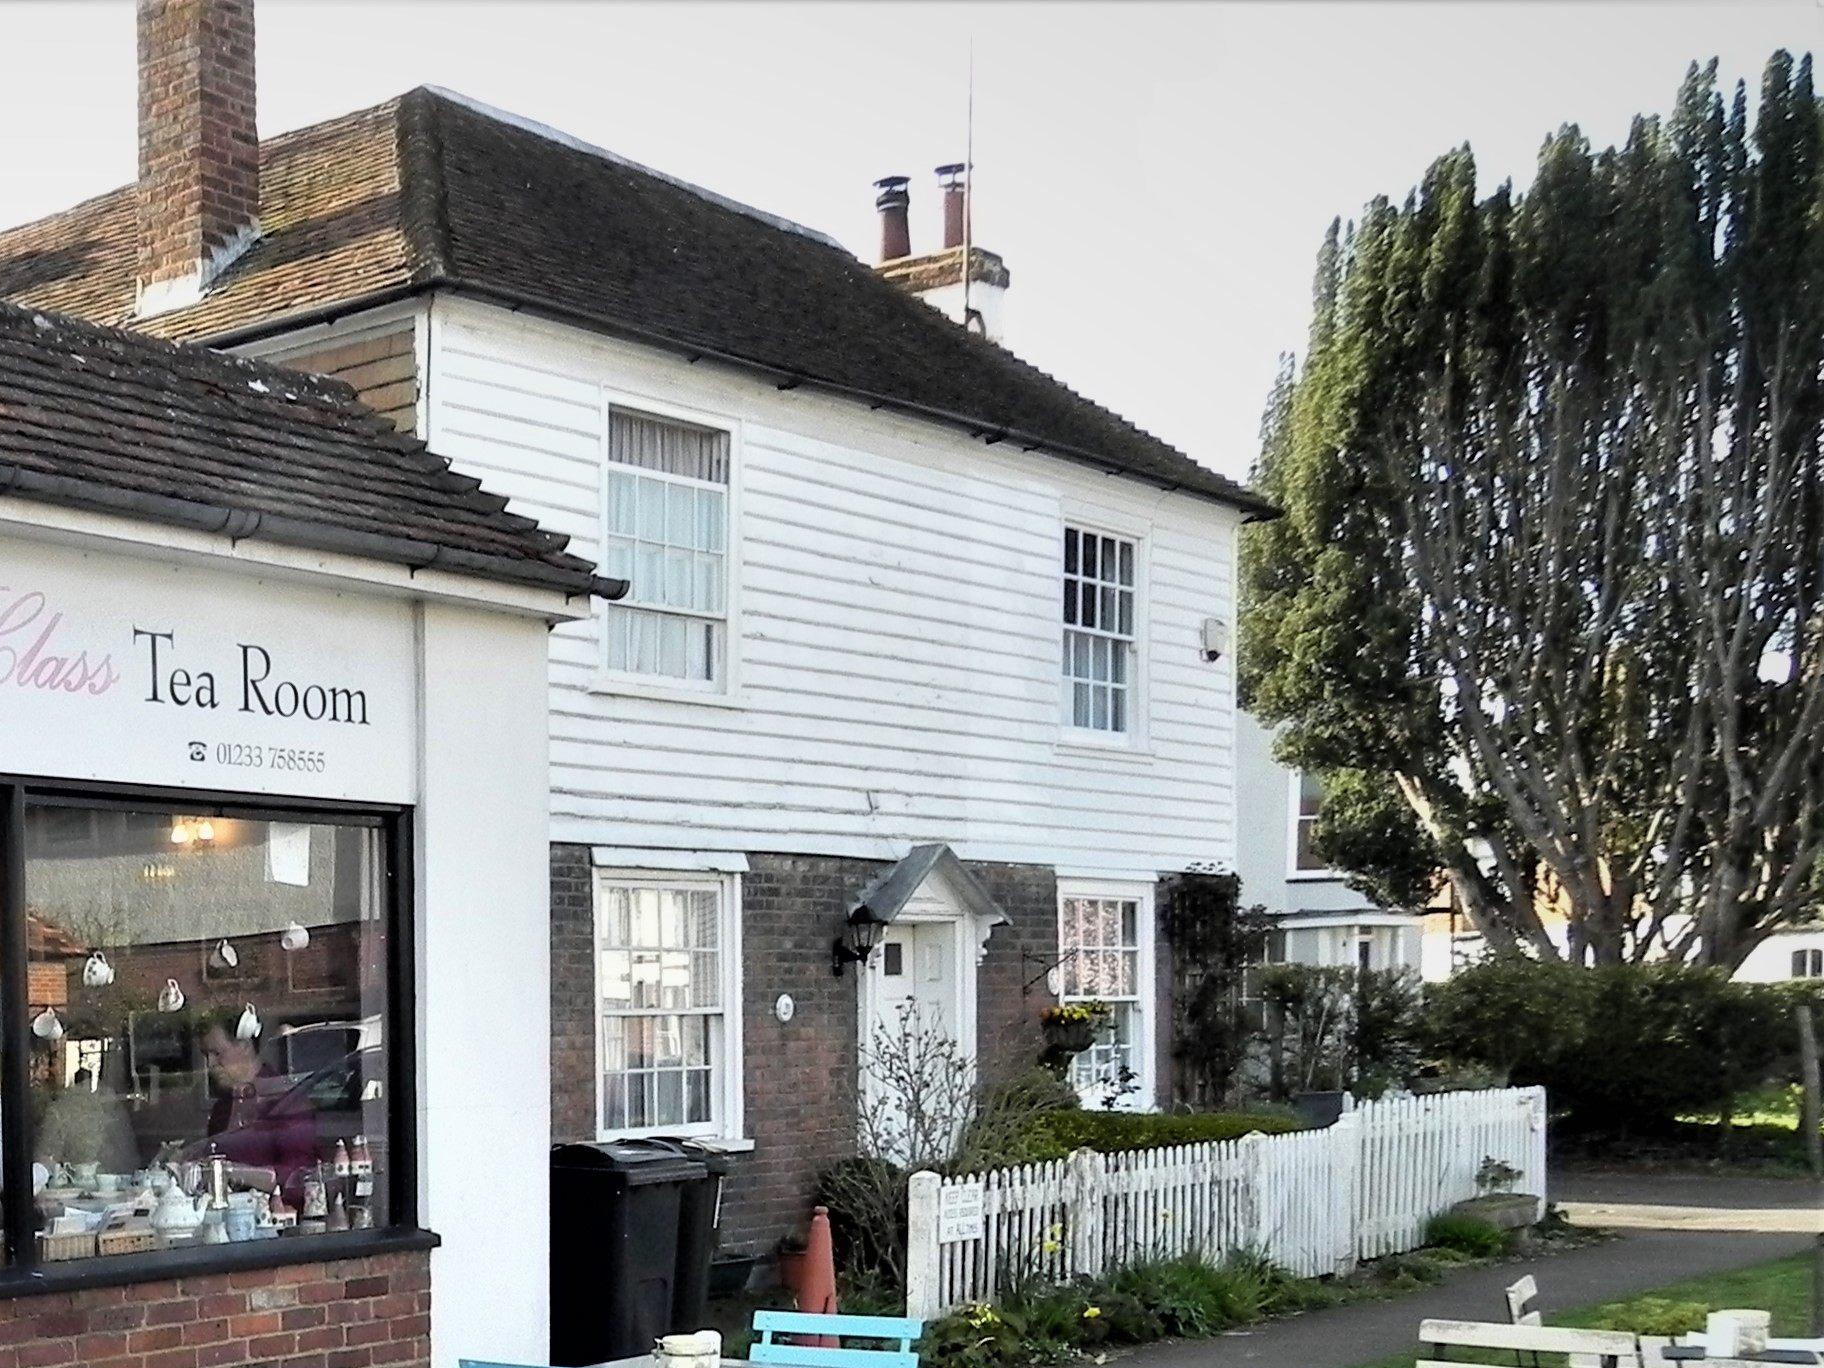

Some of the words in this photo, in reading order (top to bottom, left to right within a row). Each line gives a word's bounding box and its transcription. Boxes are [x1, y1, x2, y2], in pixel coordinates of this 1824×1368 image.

[133, 624, 218, 711] Tea
[236, 643, 371, 726] Room
[216, 742, 263, 768] 01233
[268, 747, 326, 773] 758555
